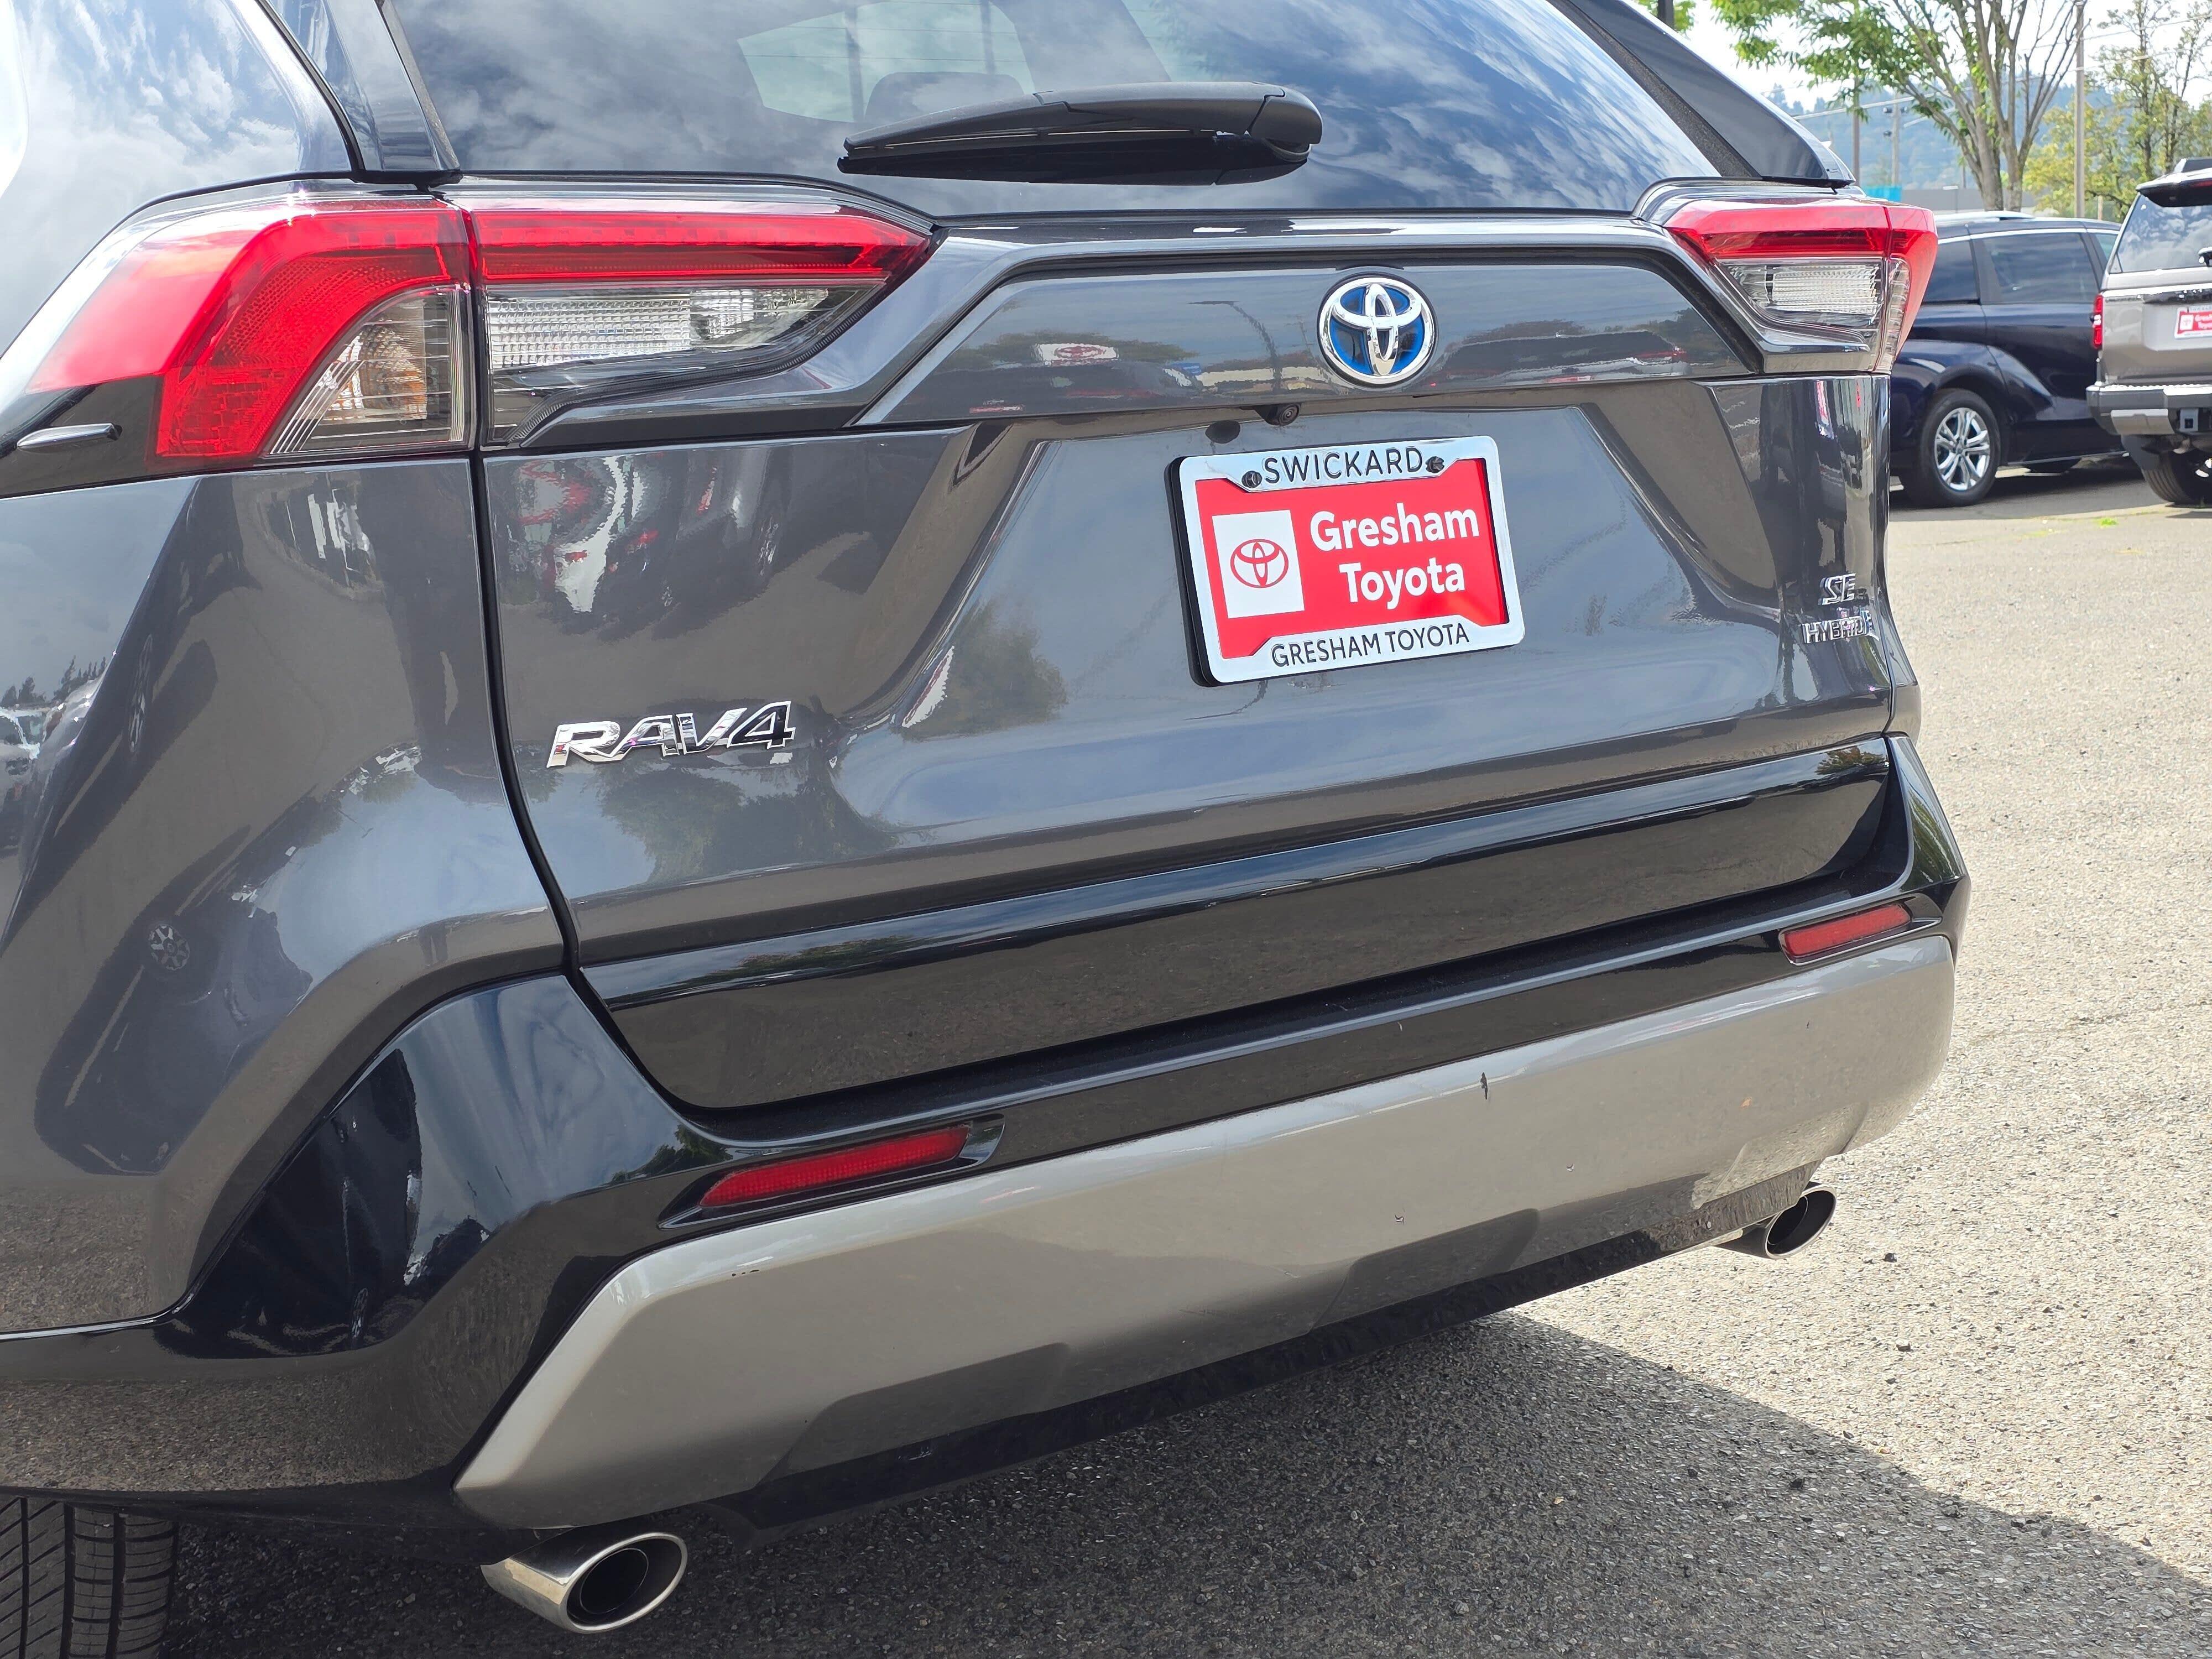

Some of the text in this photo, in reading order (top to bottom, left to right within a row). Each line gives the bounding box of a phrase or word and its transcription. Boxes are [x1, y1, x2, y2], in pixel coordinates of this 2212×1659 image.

[1264, 446, 1423, 484] SWICKARD
[1310, 502, 1479, 551] Gresham
[1339, 557, 1465, 610] Toyota
[1819, 573, 1856, 606] SE
[1271, 623, 1470, 667] GRESHAM TOYOTA
[546, 701, 796, 768] RAV4
